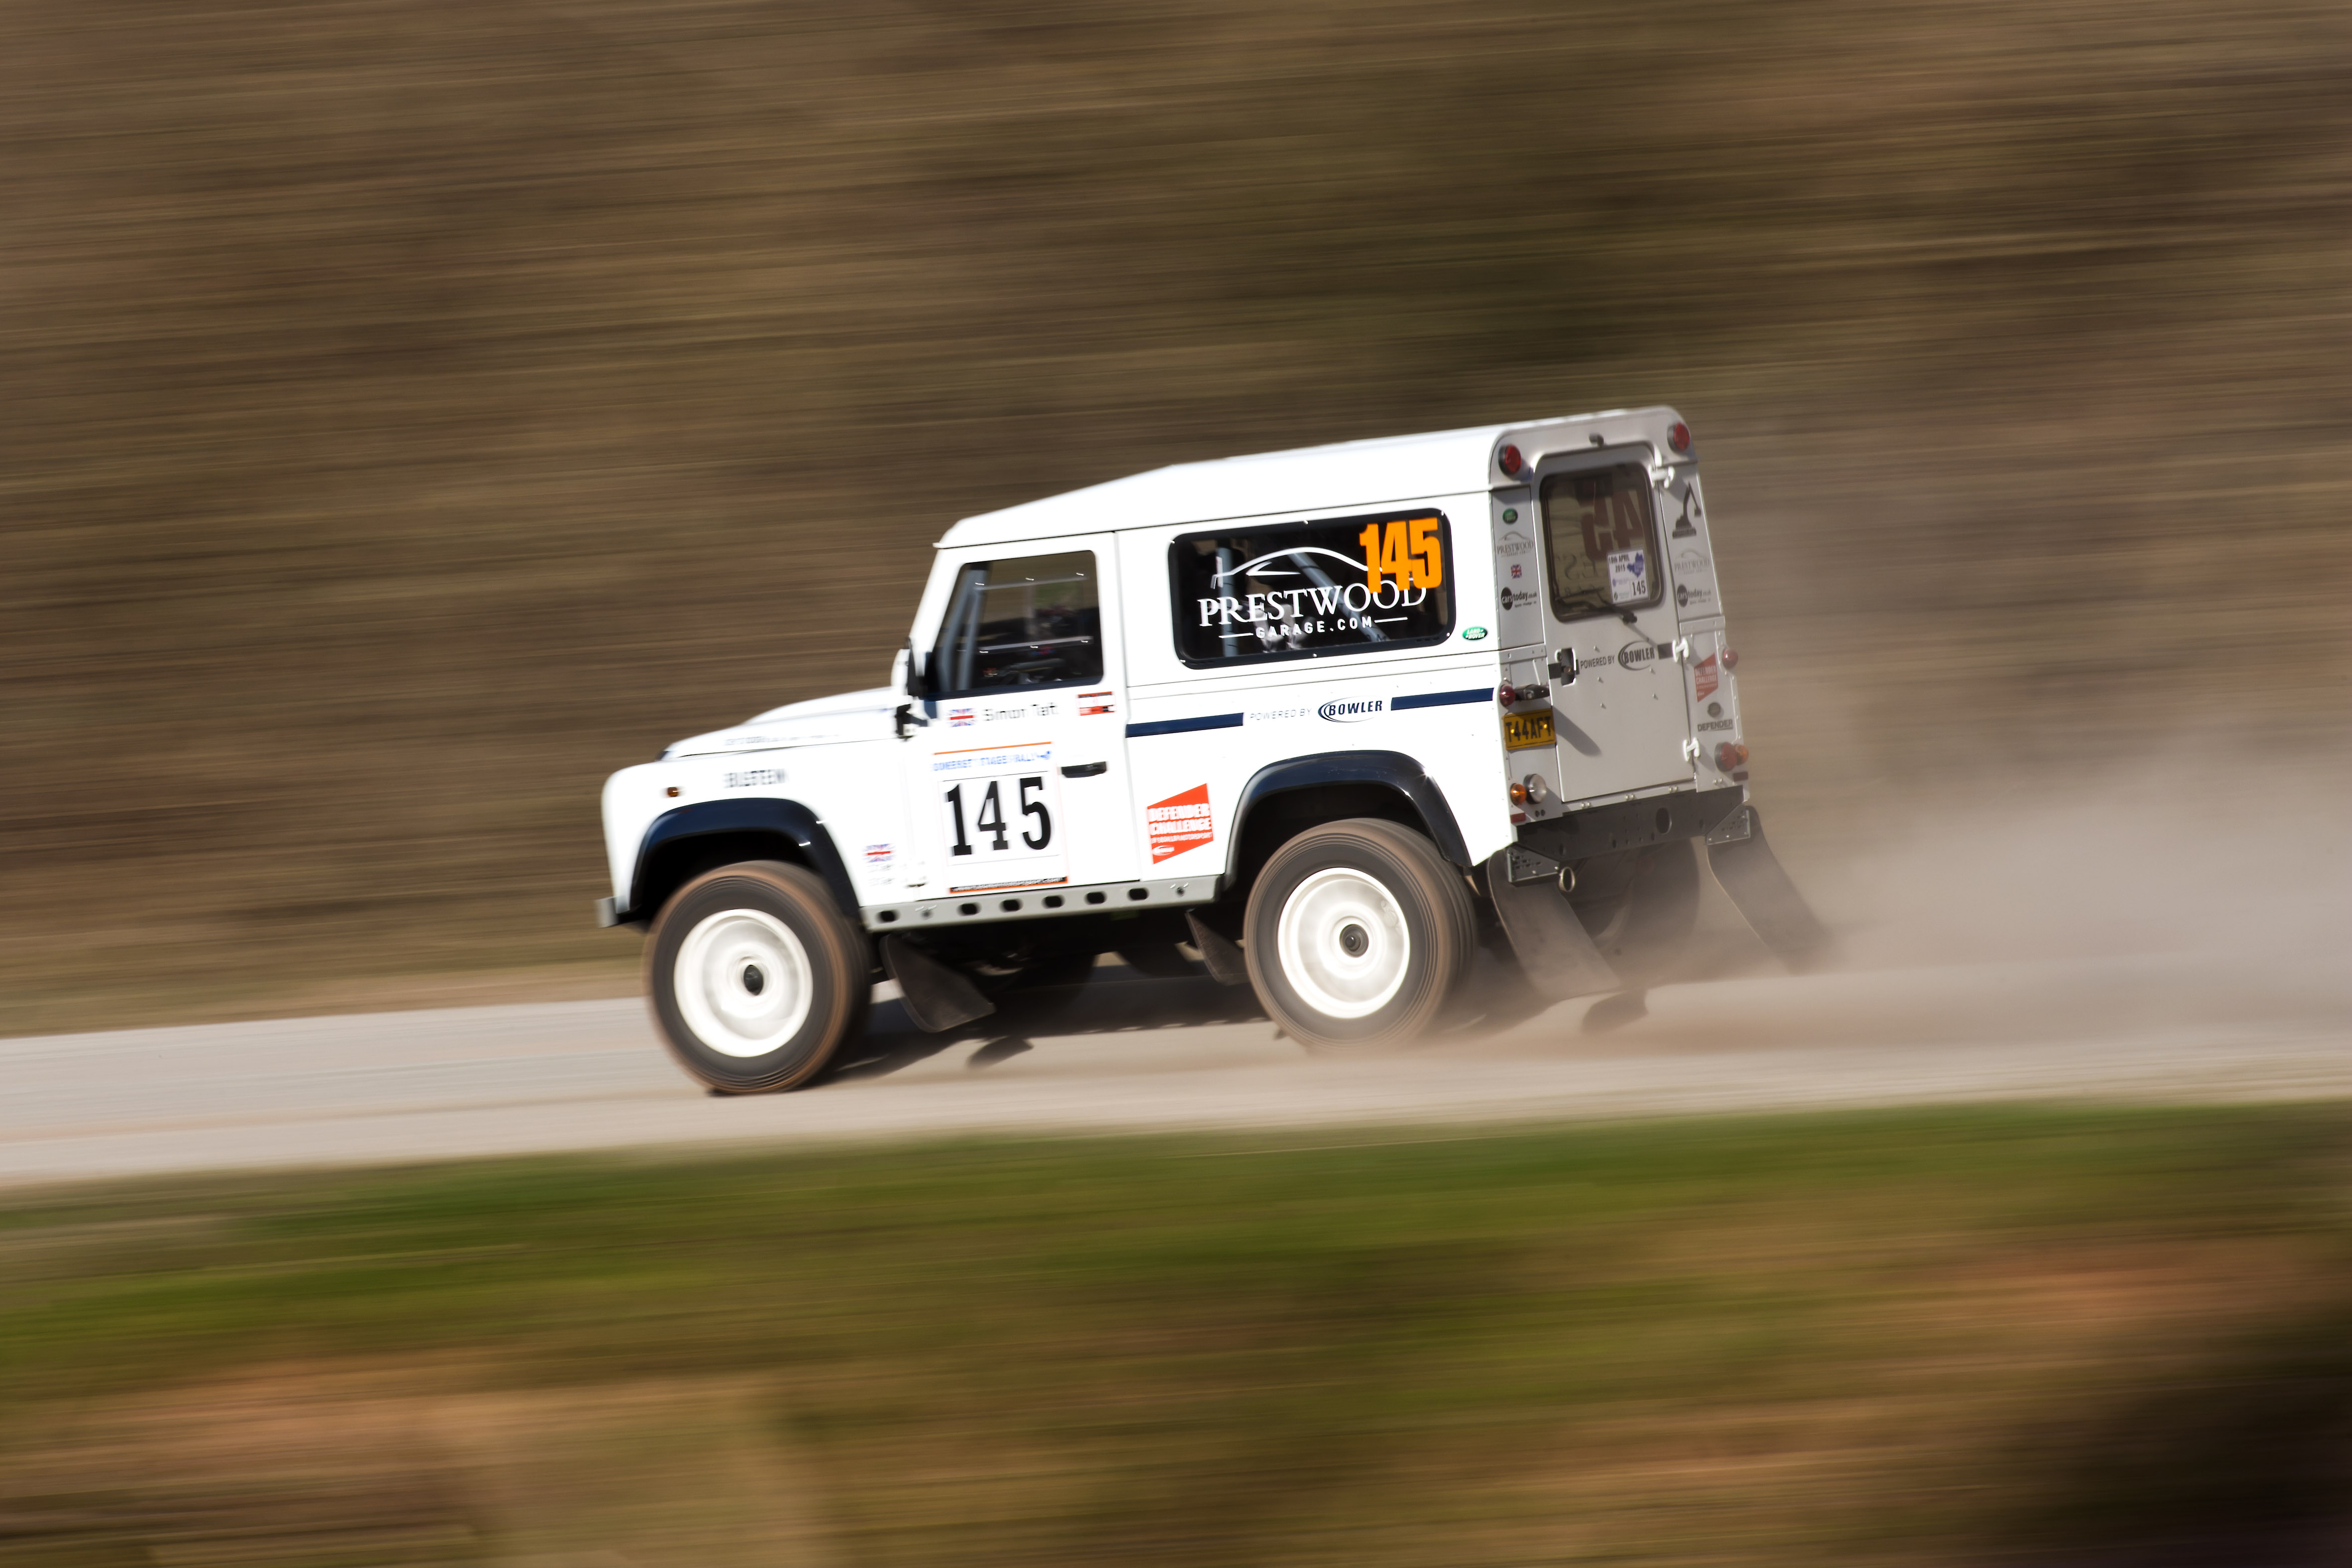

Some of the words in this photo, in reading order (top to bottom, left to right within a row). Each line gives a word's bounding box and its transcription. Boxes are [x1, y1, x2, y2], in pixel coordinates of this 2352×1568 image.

[1359, 517, 1442, 594] 145
[1619, 554, 1630, 563] APRIL
[1615, 564, 1626, 573] 2015
[1632, 580, 1646, 596] 145
[1197, 577, 1426, 627] PRESTWOOD
[1255, 616, 1372, 638] GARAGE.COM
[1580, 656, 1606, 669] POWERED
[1608, 655, 1615, 664] BY
[1623, 647, 1655, 664] BOWLER
[1250, 709, 1297, 721] POWERED
[1299, 708, 1312, 717] BY
[1328, 700, 1383, 716] BOWLER
[1698, 719, 1733, 732] DEFENDER
[945, 776, 1052, 856] 145
[1147, 803, 1210, 822] DEFENDER
[1149, 818, 1212, 835] CHALLENGE
